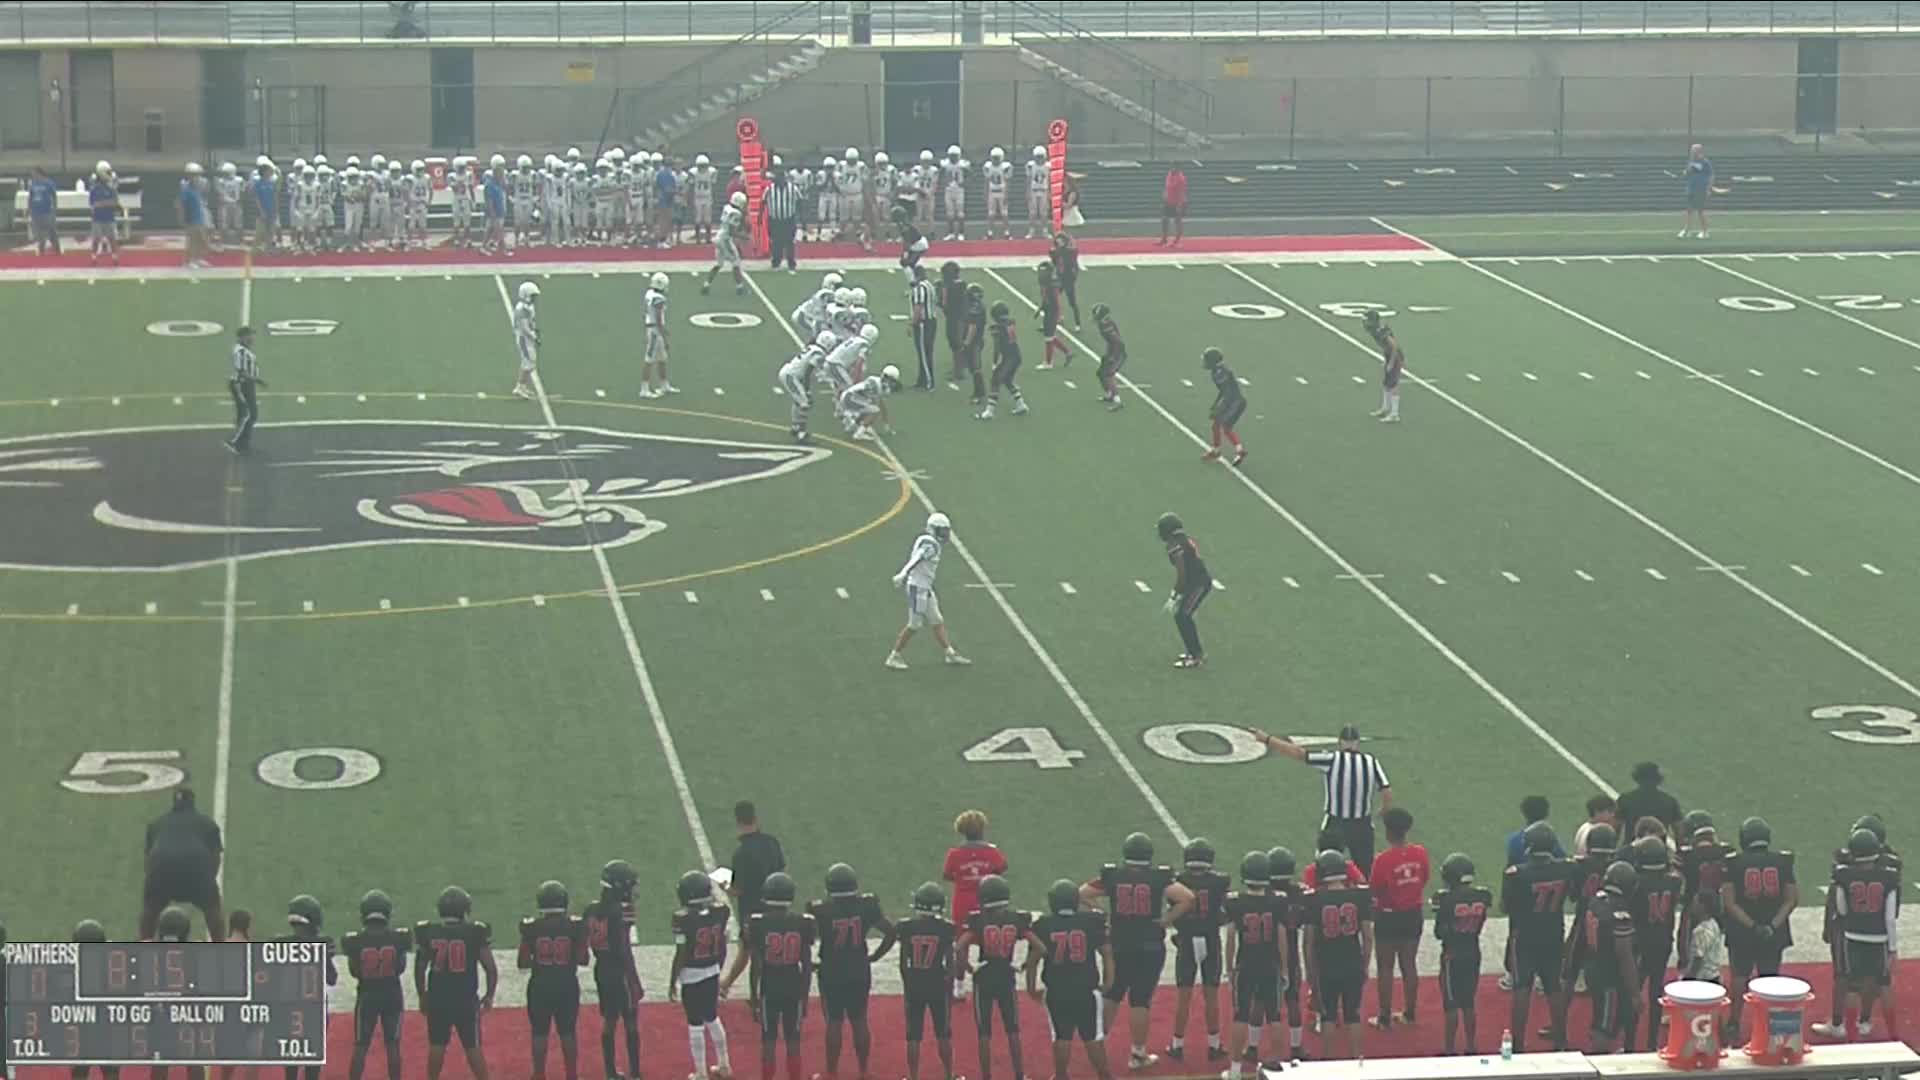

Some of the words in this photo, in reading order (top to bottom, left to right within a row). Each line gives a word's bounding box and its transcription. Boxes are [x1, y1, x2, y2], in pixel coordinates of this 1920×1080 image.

[1531, 880, 1564, 912] 77
[431, 939, 466, 972] 70
[911, 935, 939, 968] 17
[1691, 1014, 1712, 1038] G
